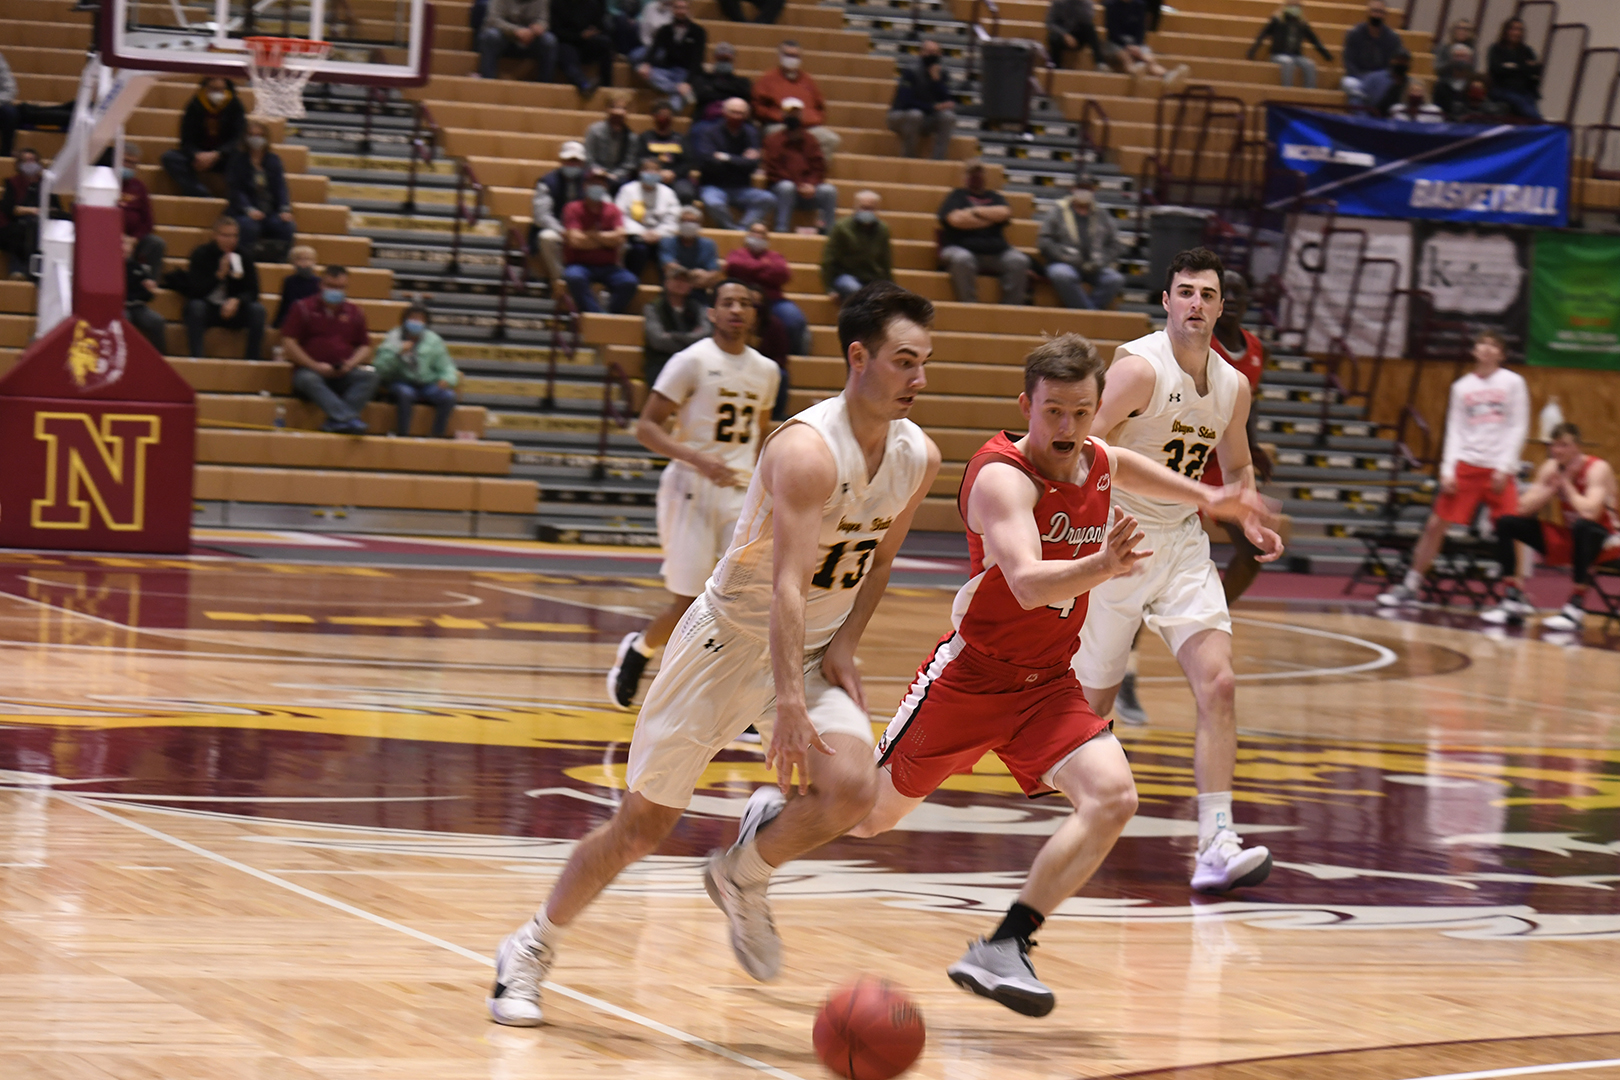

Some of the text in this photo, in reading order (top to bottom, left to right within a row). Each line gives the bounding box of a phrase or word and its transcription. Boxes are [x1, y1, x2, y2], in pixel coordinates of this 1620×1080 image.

[716, 403, 755, 444] 23
[31, 410, 161, 532] N
[810, 538, 879, 590] 13
